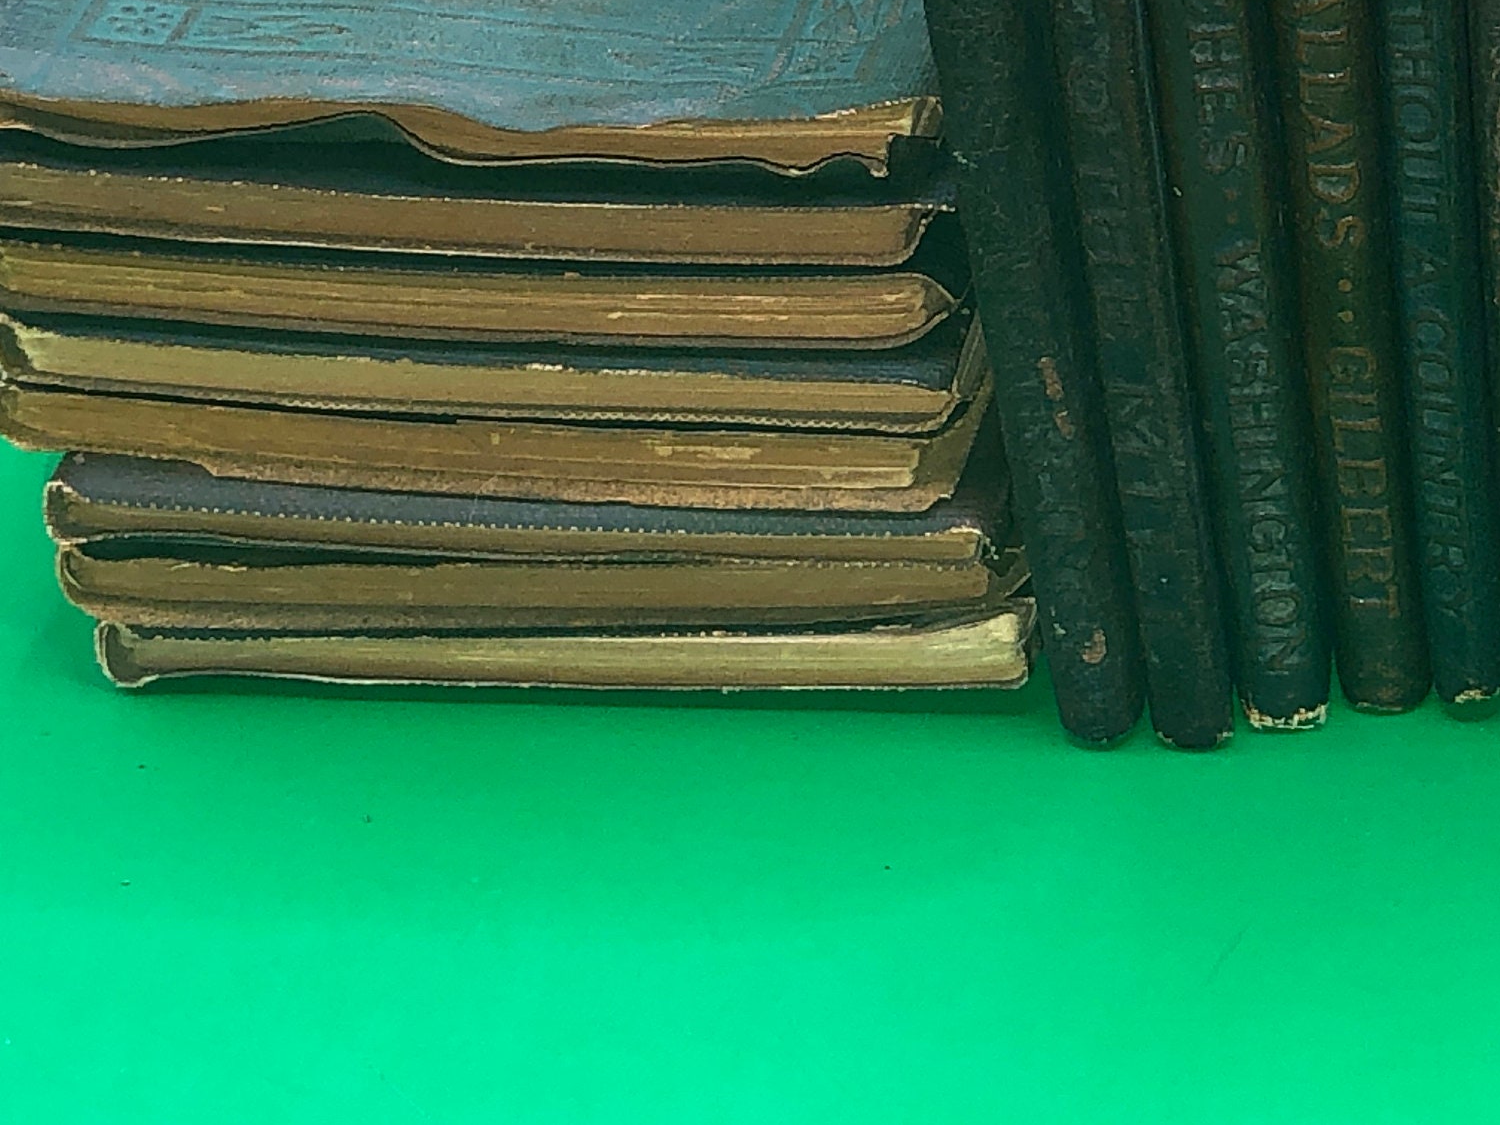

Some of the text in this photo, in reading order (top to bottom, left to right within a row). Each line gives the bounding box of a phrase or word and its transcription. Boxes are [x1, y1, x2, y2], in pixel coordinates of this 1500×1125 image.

[1214, 238, 1305, 677] WASHINGTON
[1324, 343, 1400, 621] GILBERT
[1409, 303, 1472, 622] COUNTRY
